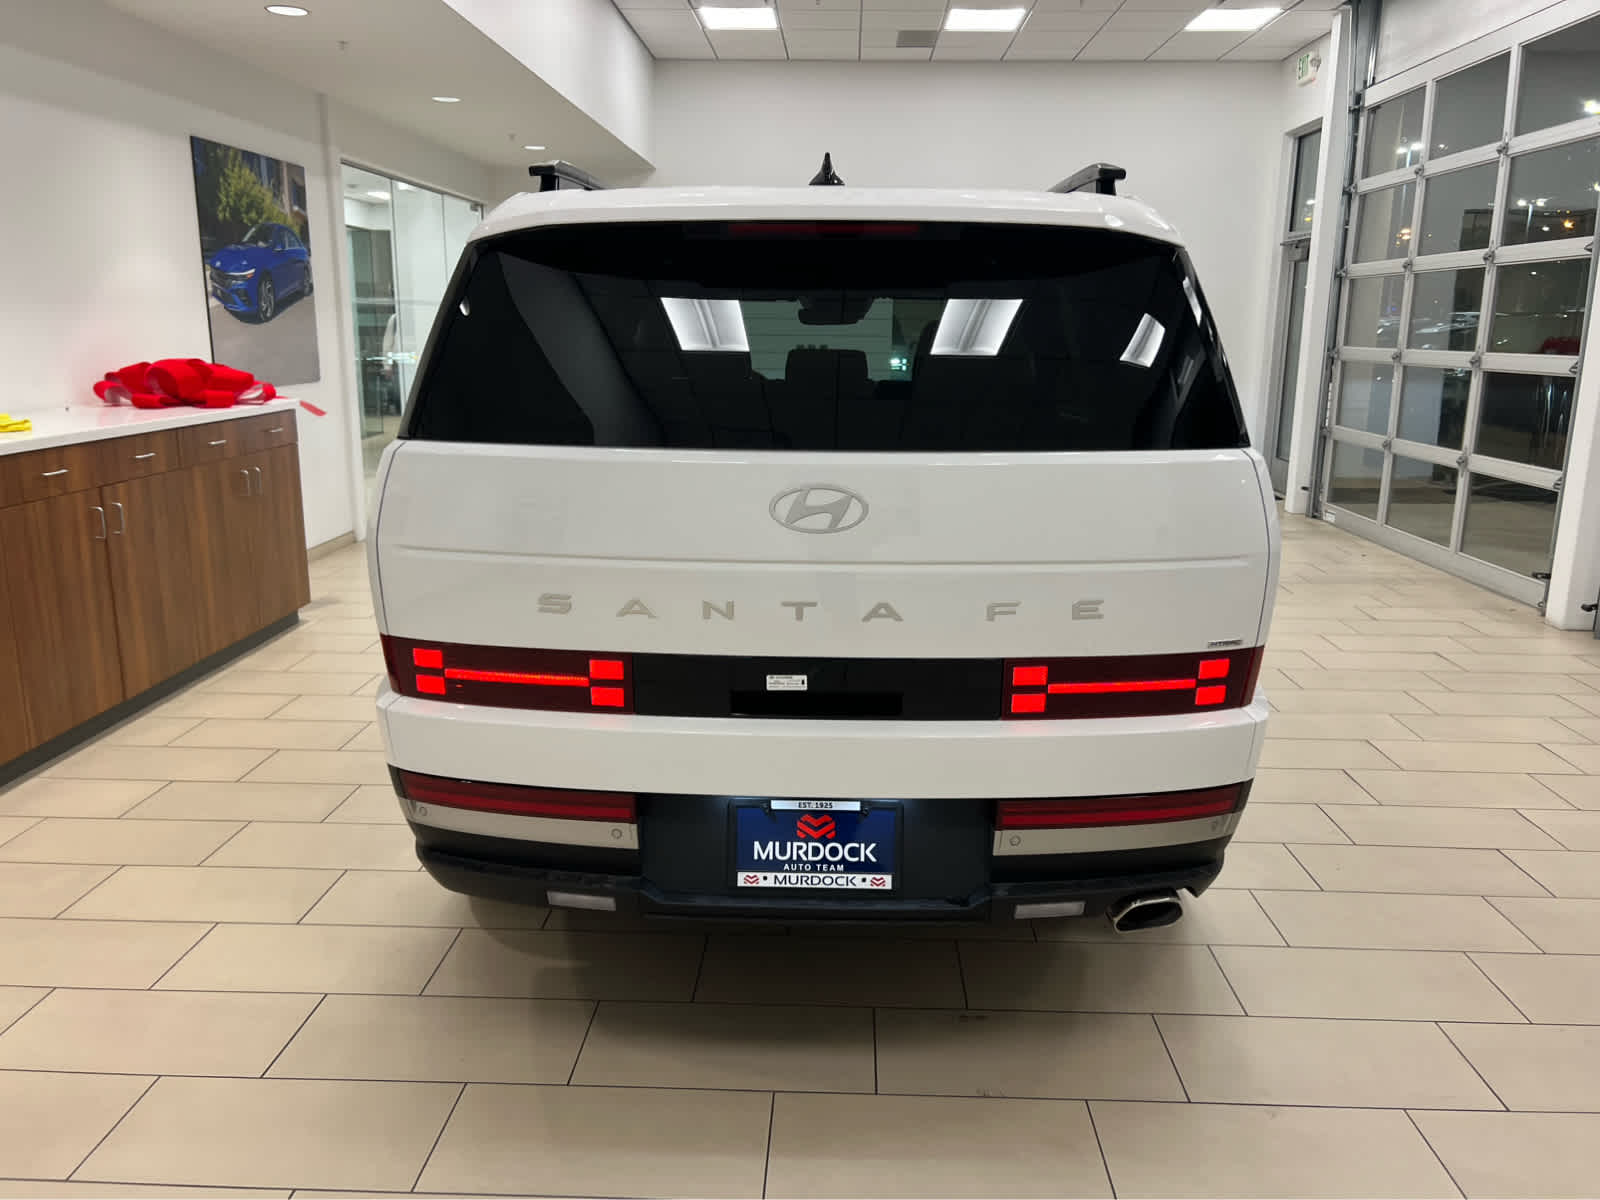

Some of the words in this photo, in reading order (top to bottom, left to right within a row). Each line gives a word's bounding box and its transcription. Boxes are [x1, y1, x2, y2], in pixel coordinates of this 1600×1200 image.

[537, 592, 904, 623] SANTA
[985, 599, 1105, 622] FE
[798, 801, 814, 809] EST.
[815, 801, 833, 809] 1925
[753, 840, 878, 863] MURDOCK
[783, 863, 812, 872] AUTO
[817, 863, 845, 872] TEAM
[773, 874, 857, 887] MURDOCK
